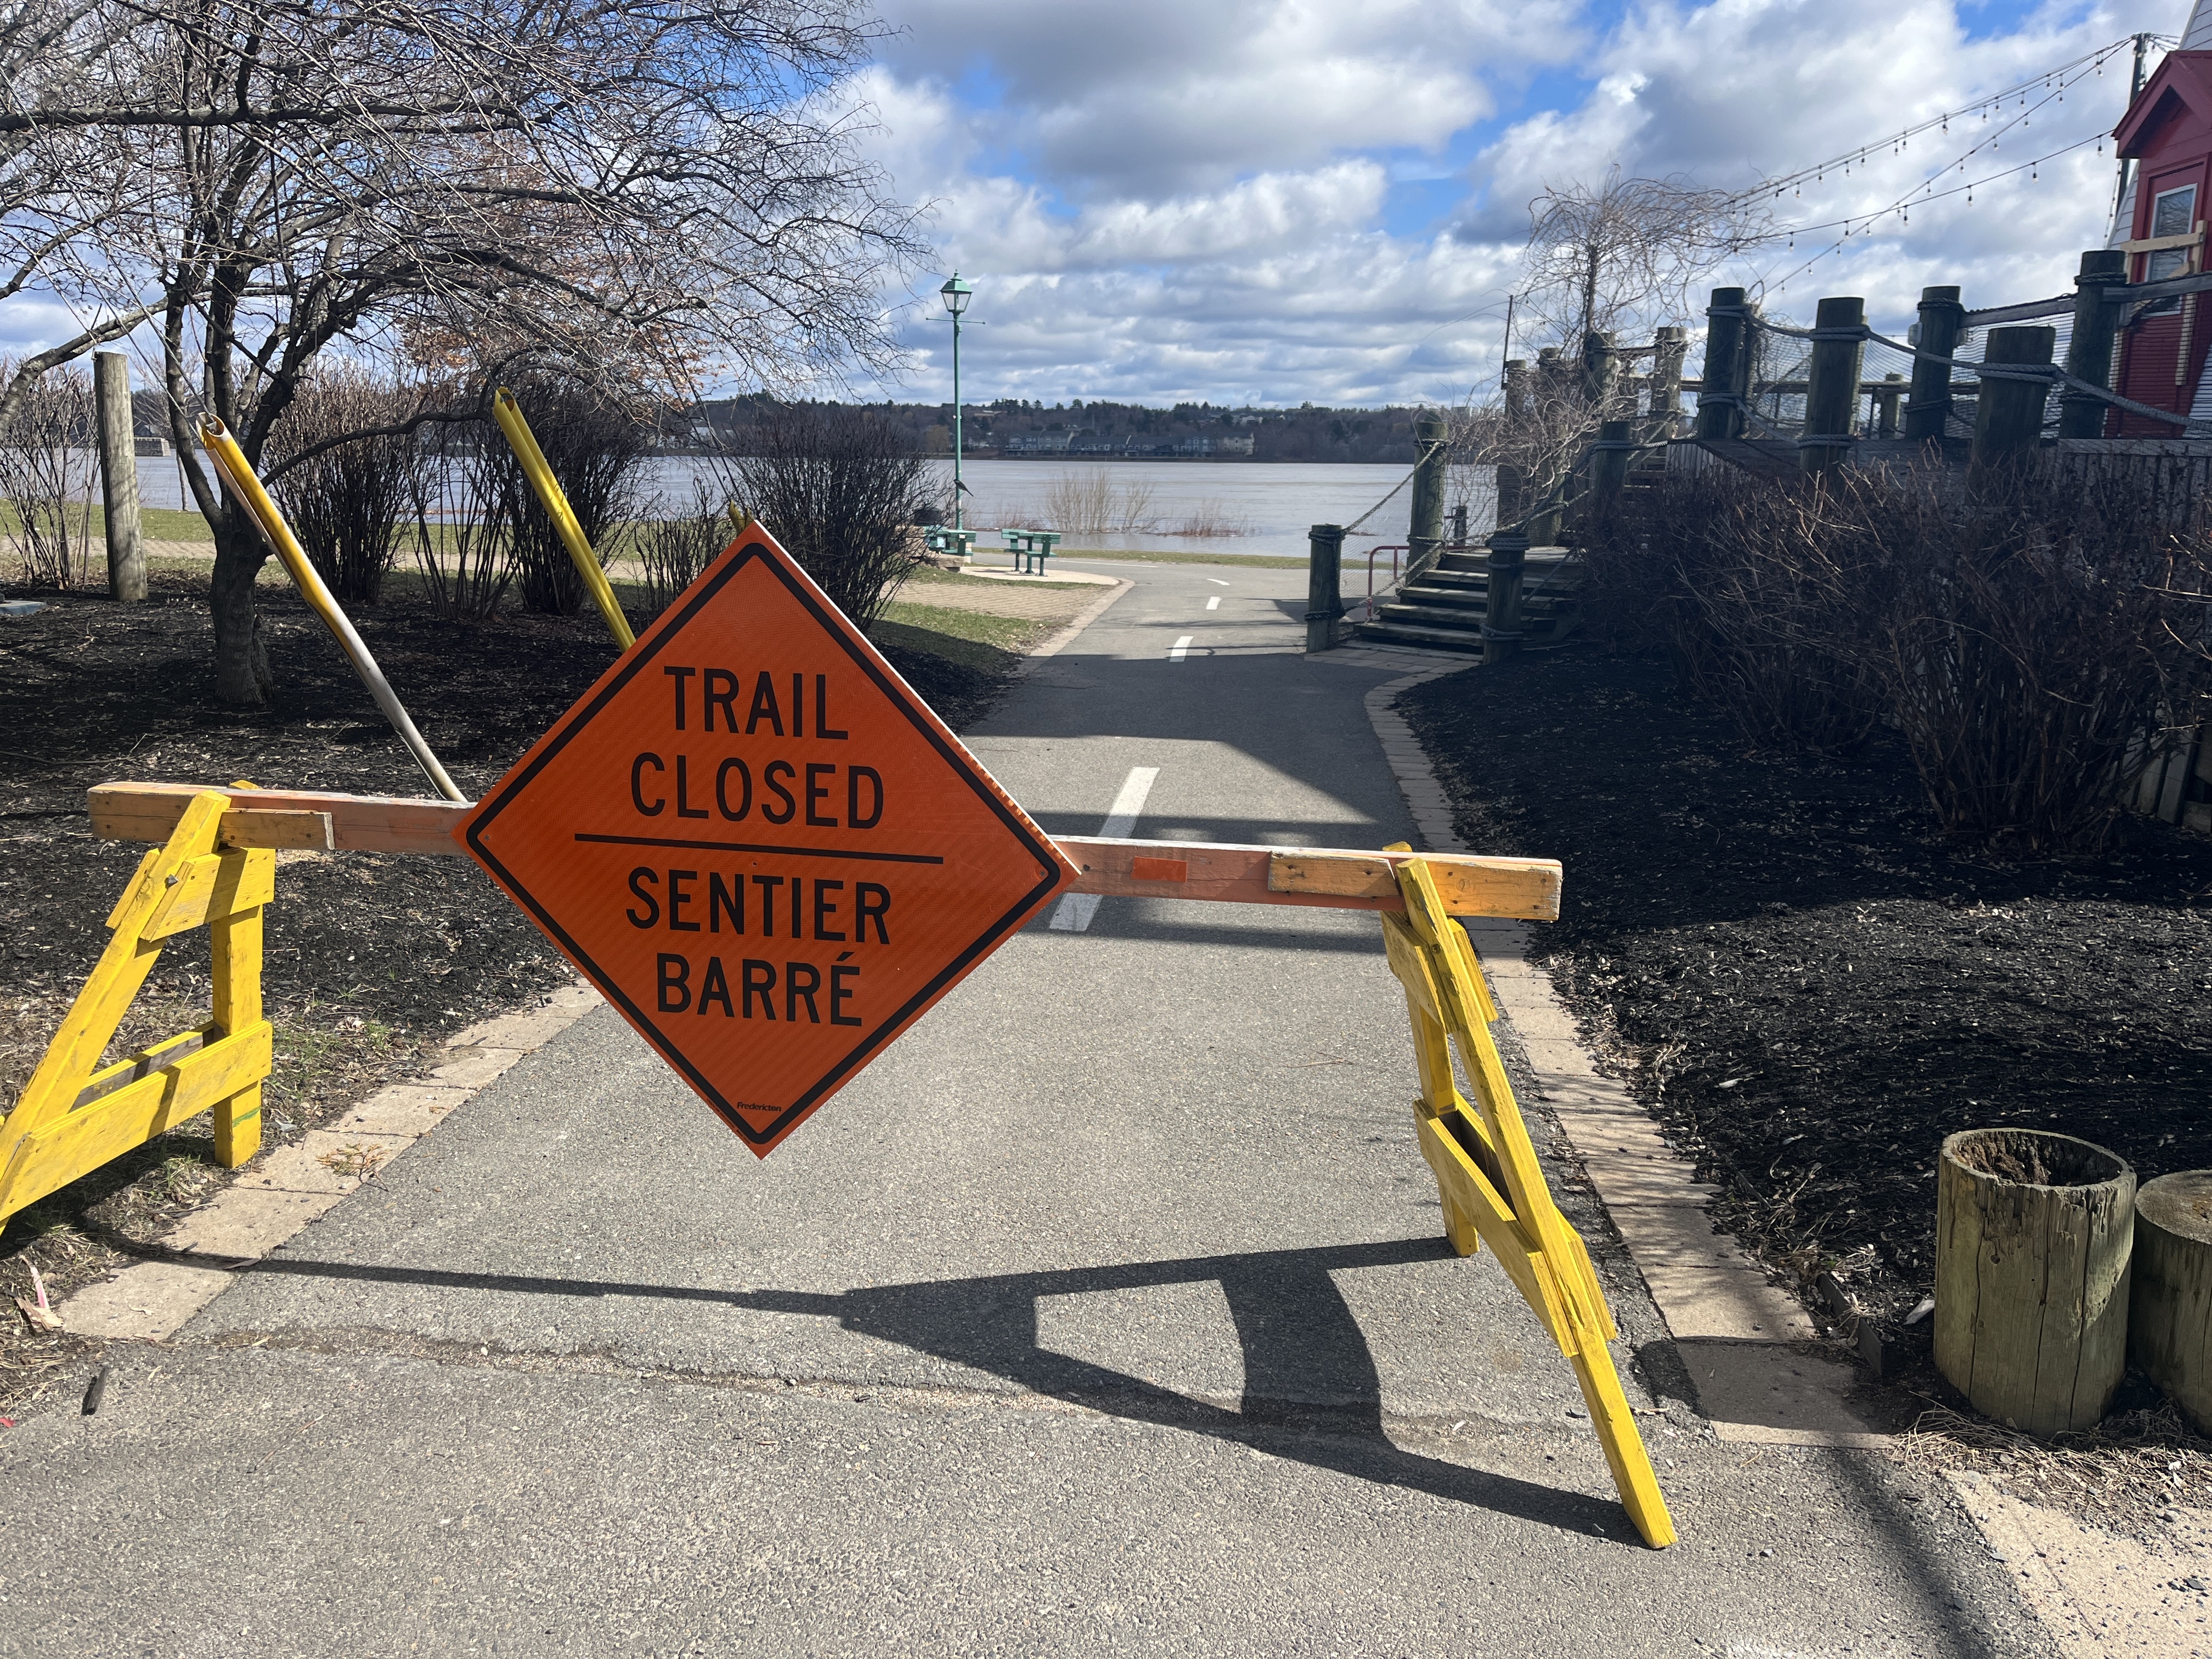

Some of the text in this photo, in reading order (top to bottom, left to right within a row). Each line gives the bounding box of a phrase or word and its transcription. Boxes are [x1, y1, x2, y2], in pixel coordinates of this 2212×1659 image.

[664, 665, 849, 740] TRAIL
[631, 752, 884, 830] CLOSED
[626, 866, 891, 945] SENTIER
[657, 951, 862, 1027] BARRÉ
[737, 1101, 781, 1112] Fredericton
